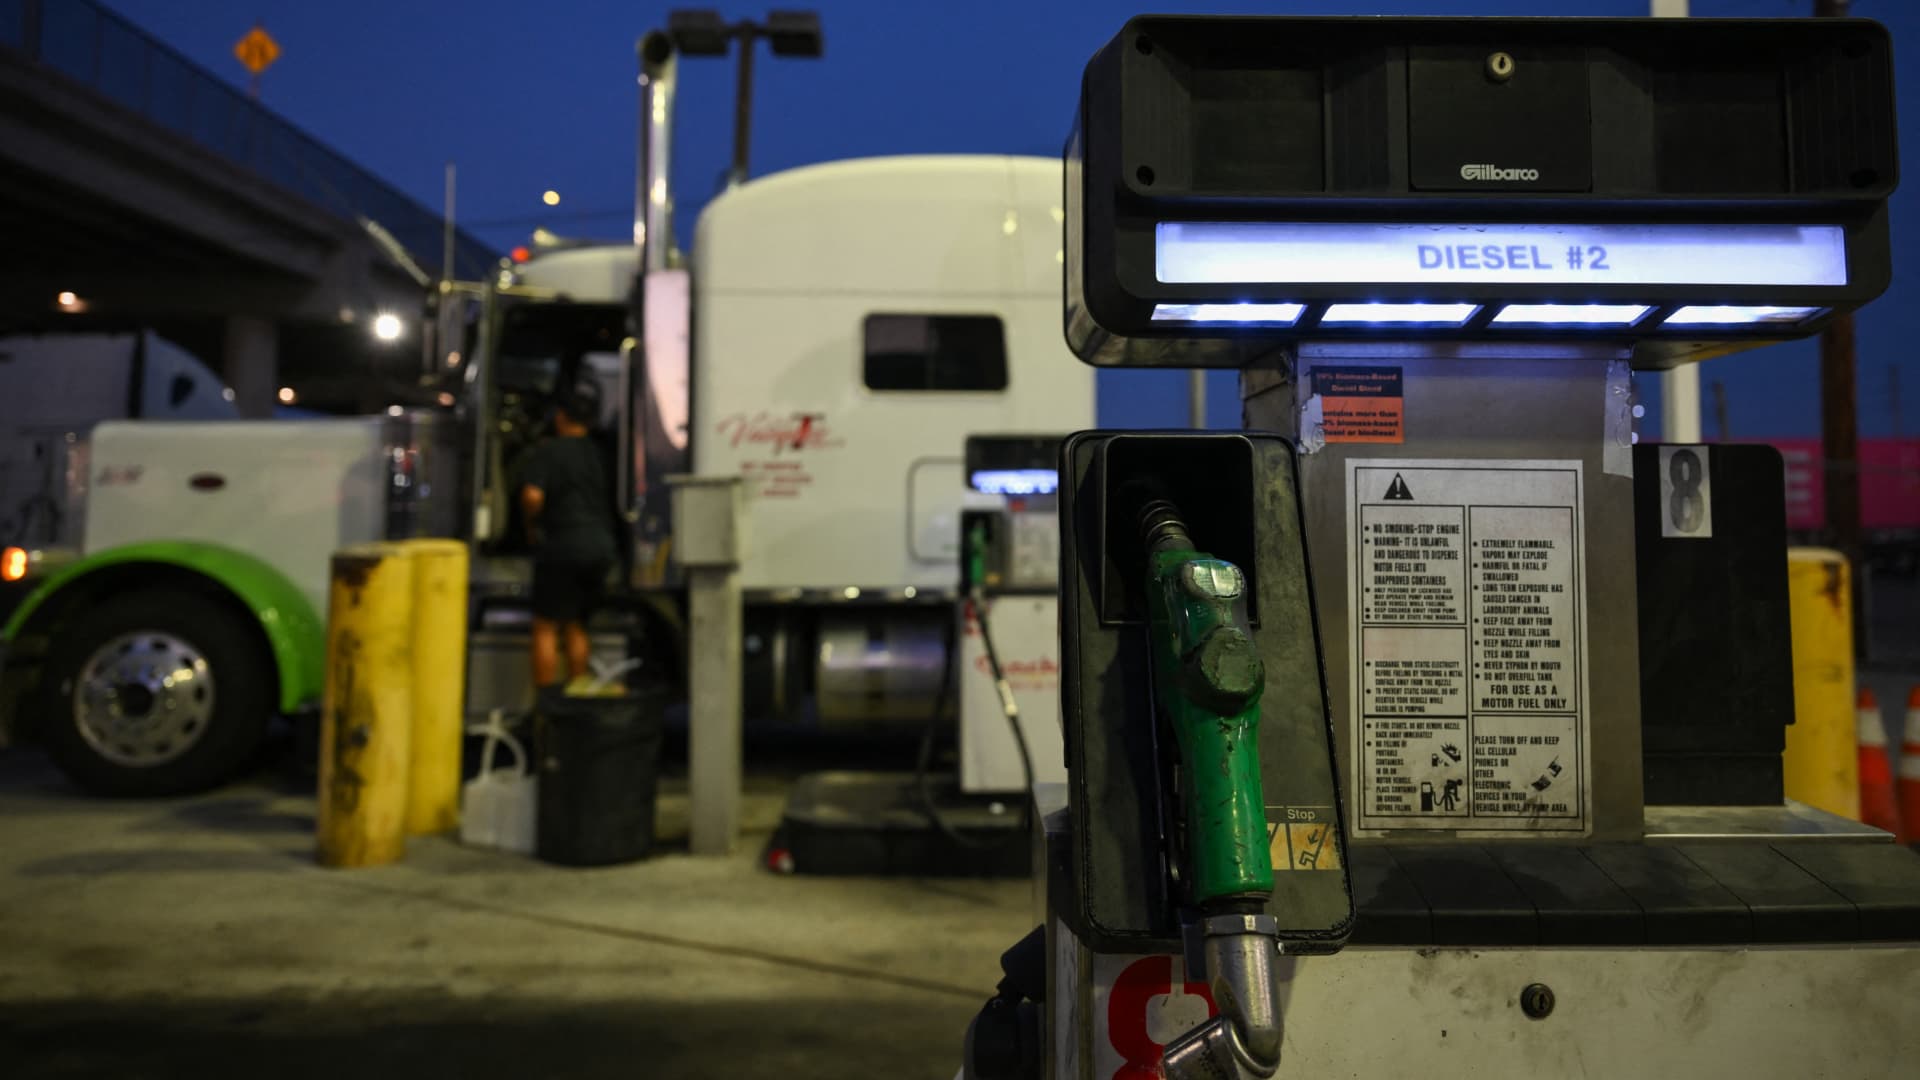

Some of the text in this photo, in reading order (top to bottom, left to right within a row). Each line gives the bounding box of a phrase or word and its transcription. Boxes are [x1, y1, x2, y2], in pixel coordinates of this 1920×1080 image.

[1460, 164, 1539, 181] Gilbarco
[1417, 245, 1610, 270] DIESEL #2
[1670, 449, 1704, 533] 8
[1482, 540, 1515, 548] EXTREMELY
[1482, 551, 1547, 559] VAPORS MAY EXPLODE
[1482, 562, 1509, 570] HARMFUL
[1512, 562, 1520, 570] OR
[1522, 562, 1539, 570] FATAL
[1483, 573, 1518, 581] SWALLOWED
[1483, 584, 1563, 593] LONG TERM EXPOSURE HAS
[1483, 595, 1540, 603] CAUSED CANCER IN
[1483, 606, 1549, 614] LABORATORY ANIMALS
[1483, 617, 1552, 625] KEEP FACE AWAY FROM
[1483, 628, 1550, 637] NOZZLE WHILE FILLING
[1484, 639, 1560, 648] KEEP NOZZLE AWAY FROM
[1484, 650, 1530, 659] EYES AND SKIN
[1484, 661, 1561, 670] NEVER SYPHON BY MOUTH
[1484, 672, 1552, 681] DO NOT OVERFILL TANK
[1491, 685, 1557, 695] FOR USE AS A
[1482, 698, 1566, 709] MOTOR FUEL ONLY
[1287, 809, 1316, 821] Stop
